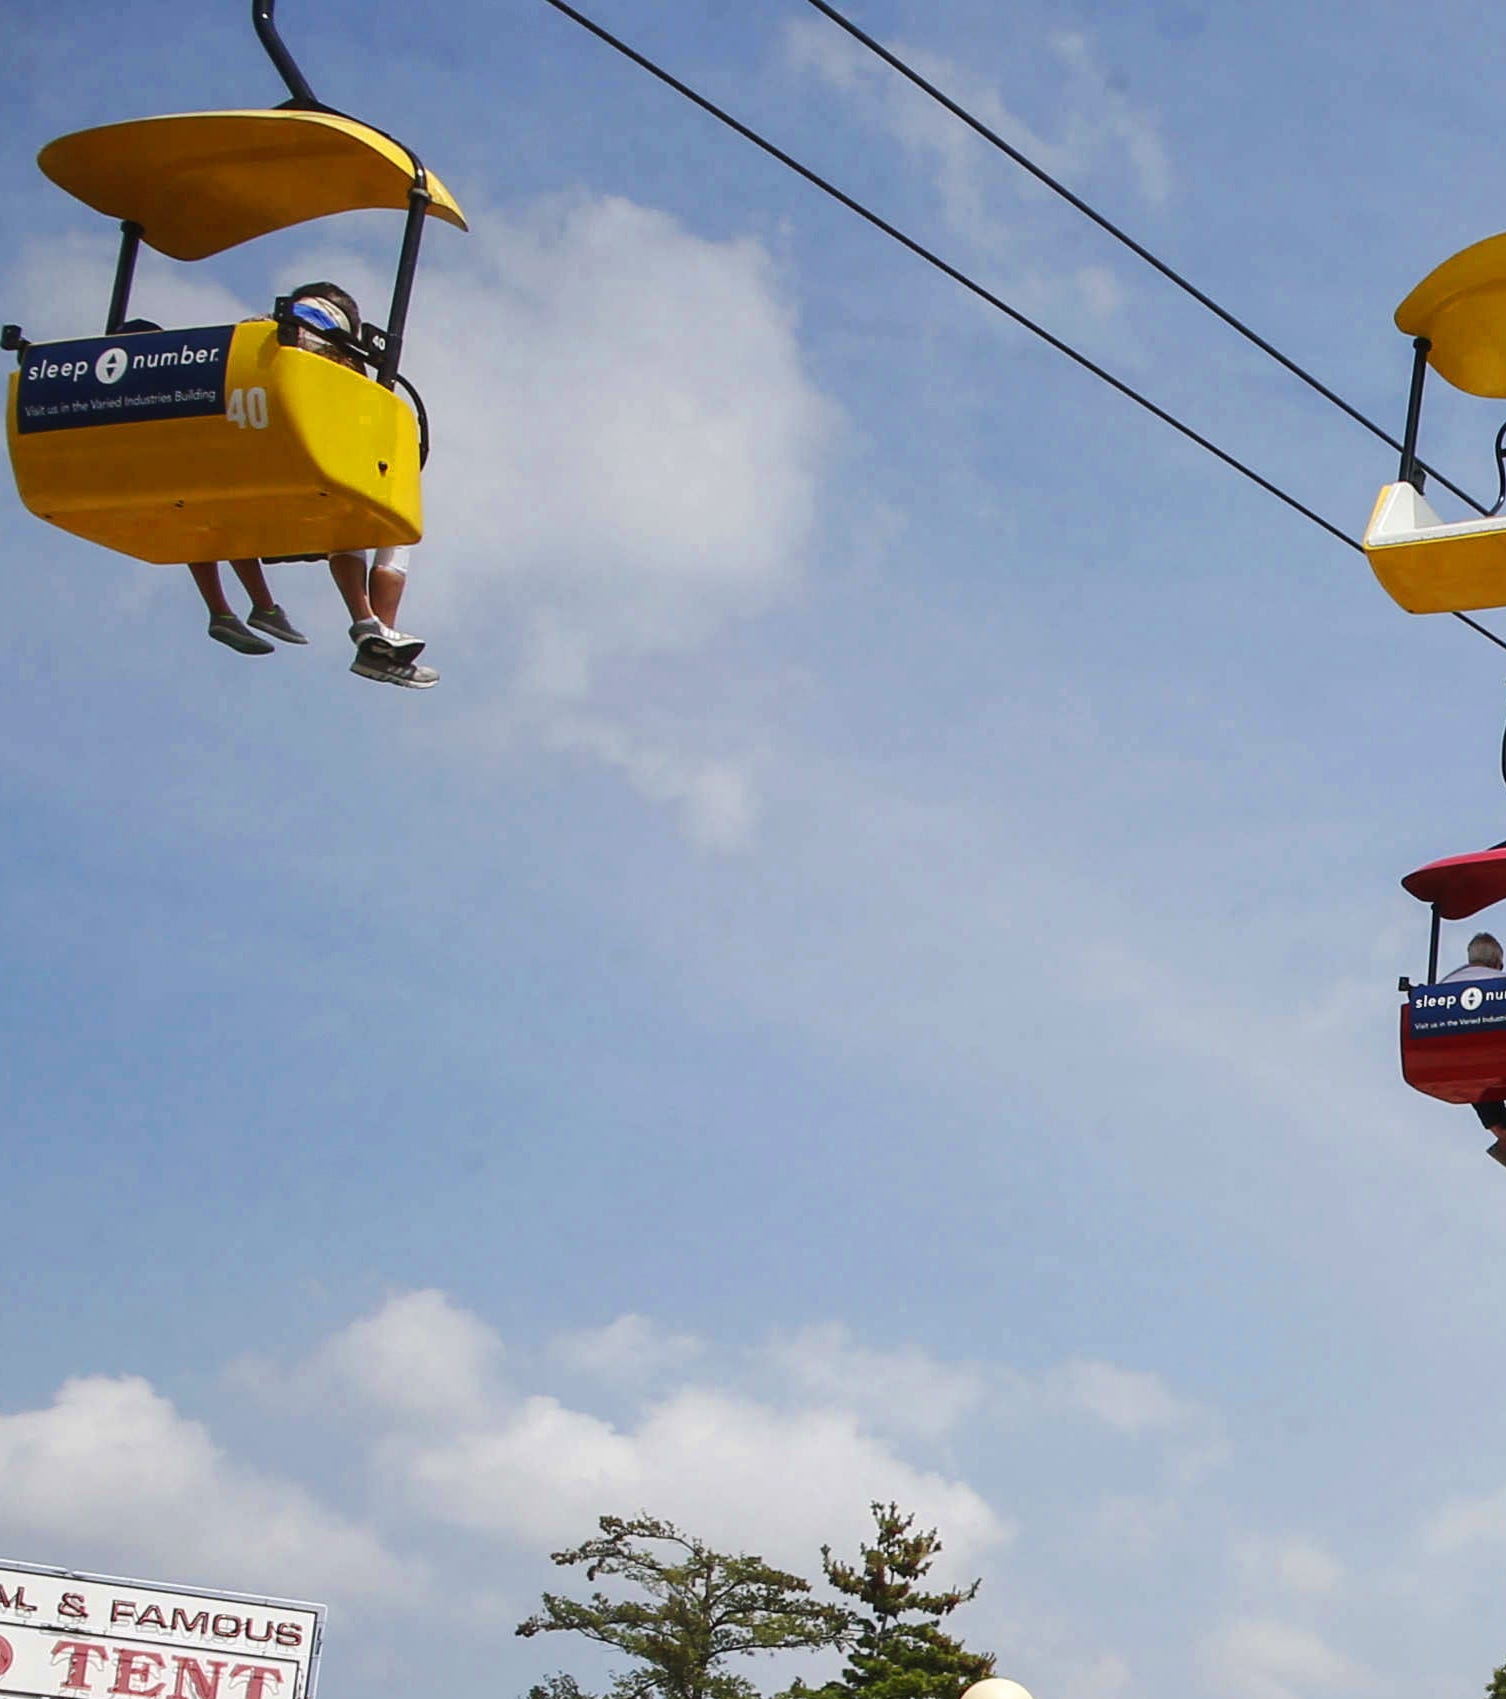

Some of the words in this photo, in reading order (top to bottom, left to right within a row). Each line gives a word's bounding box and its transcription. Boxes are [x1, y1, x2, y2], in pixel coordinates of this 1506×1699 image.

[28, 360, 88, 382] sleep
[24, 405, 46, 417] Visit
[47, 405, 59, 415] us
[61, 403, 69, 413] in
[72, 400, 88, 412] the
[90, 397, 122, 410] Varied
[124, 393, 173, 406] Industries
[174, 389, 217, 403] Building
[226, 387, 269, 430] 40
[1415, 994, 1457, 1010] sleep
[1414, 1022, 1429, 1031] Visit
[1447, 1019, 1458, 1027] the
[57, 1591, 89, 1618] &
[110, 1599, 303, 1647] FAMOUS
